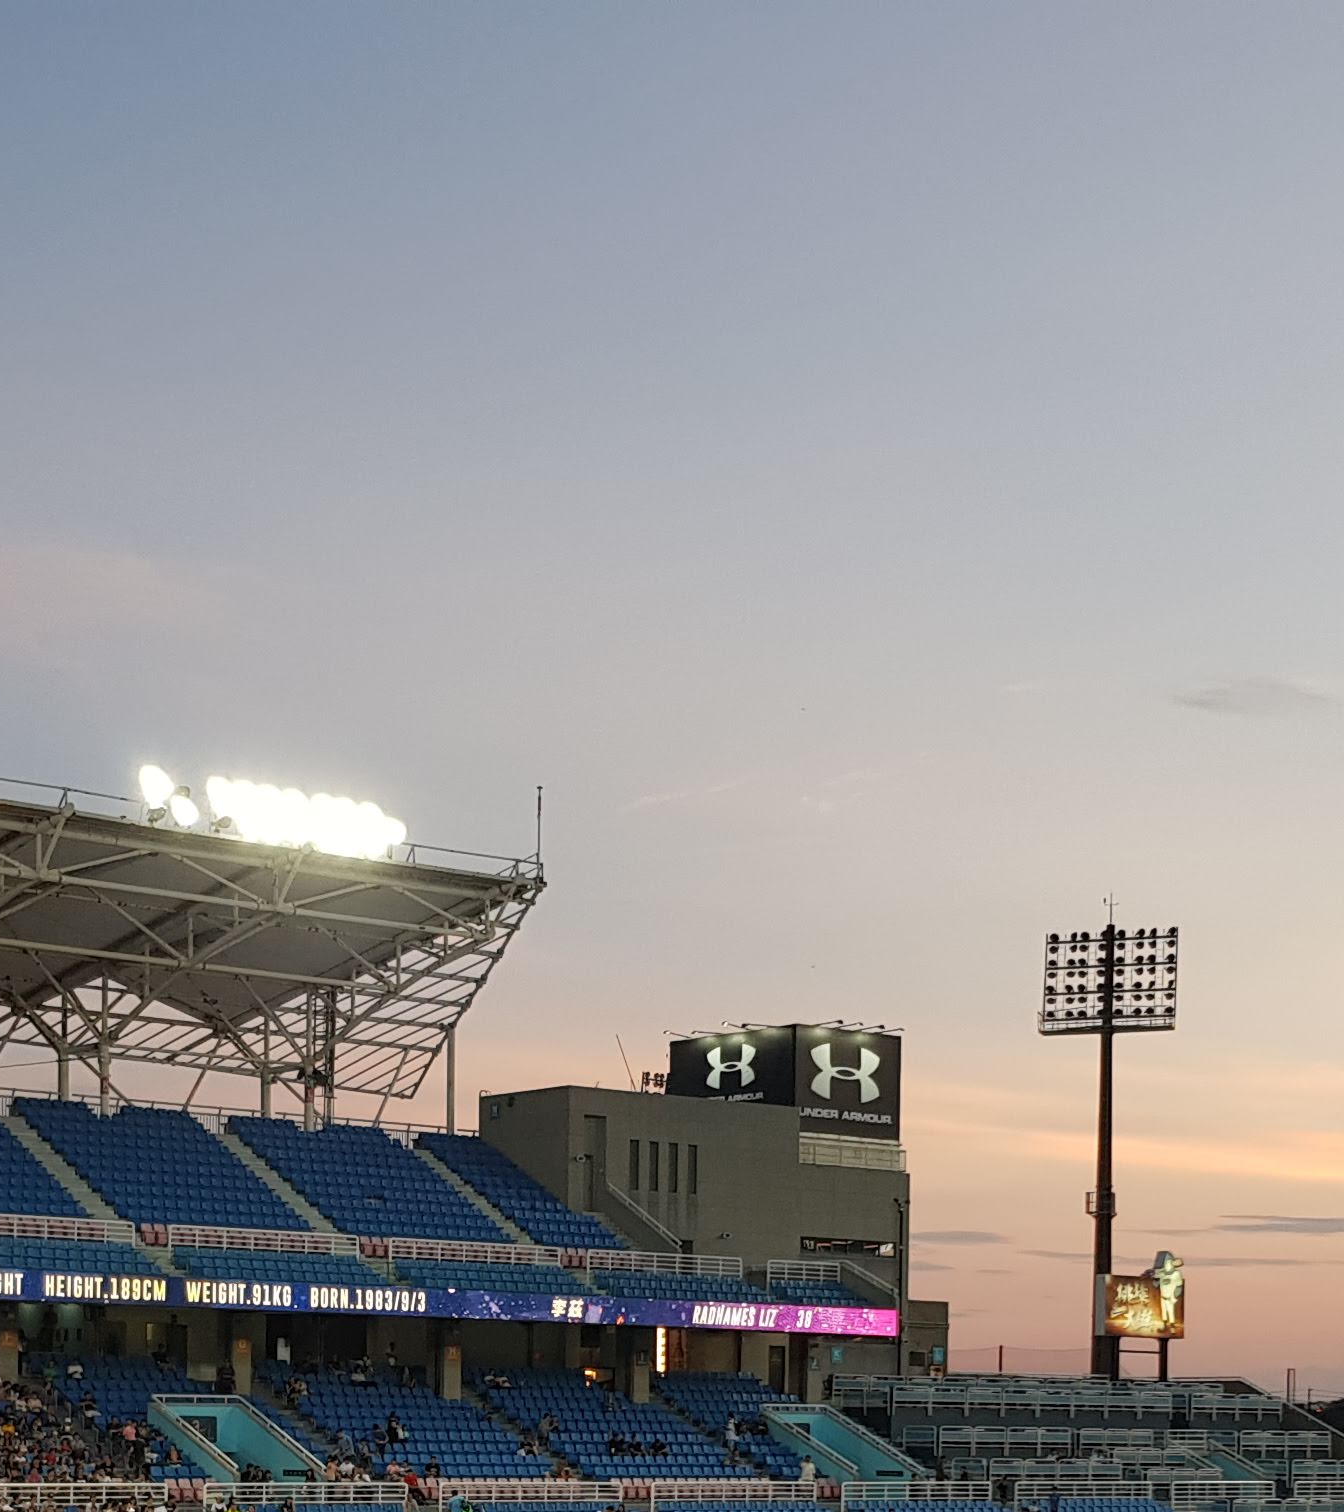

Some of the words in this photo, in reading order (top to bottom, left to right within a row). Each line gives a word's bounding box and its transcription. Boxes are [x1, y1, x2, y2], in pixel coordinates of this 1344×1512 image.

[799, 1107, 839, 1120] UNDER
[841, 1111, 893, 1125] ARMOUR
[44, 1274, 167, 1303] HEIGHT.189CM
[186, 1280, 293, 1308] WEIGHT.91KG
[309, 1286, 427, 1313] BORN.1983/9/3
[692, 1303, 755, 1327] RADHAMES
[758, 1307, 778, 1328] LIZ
[796, 1309, 813, 1330] 38
